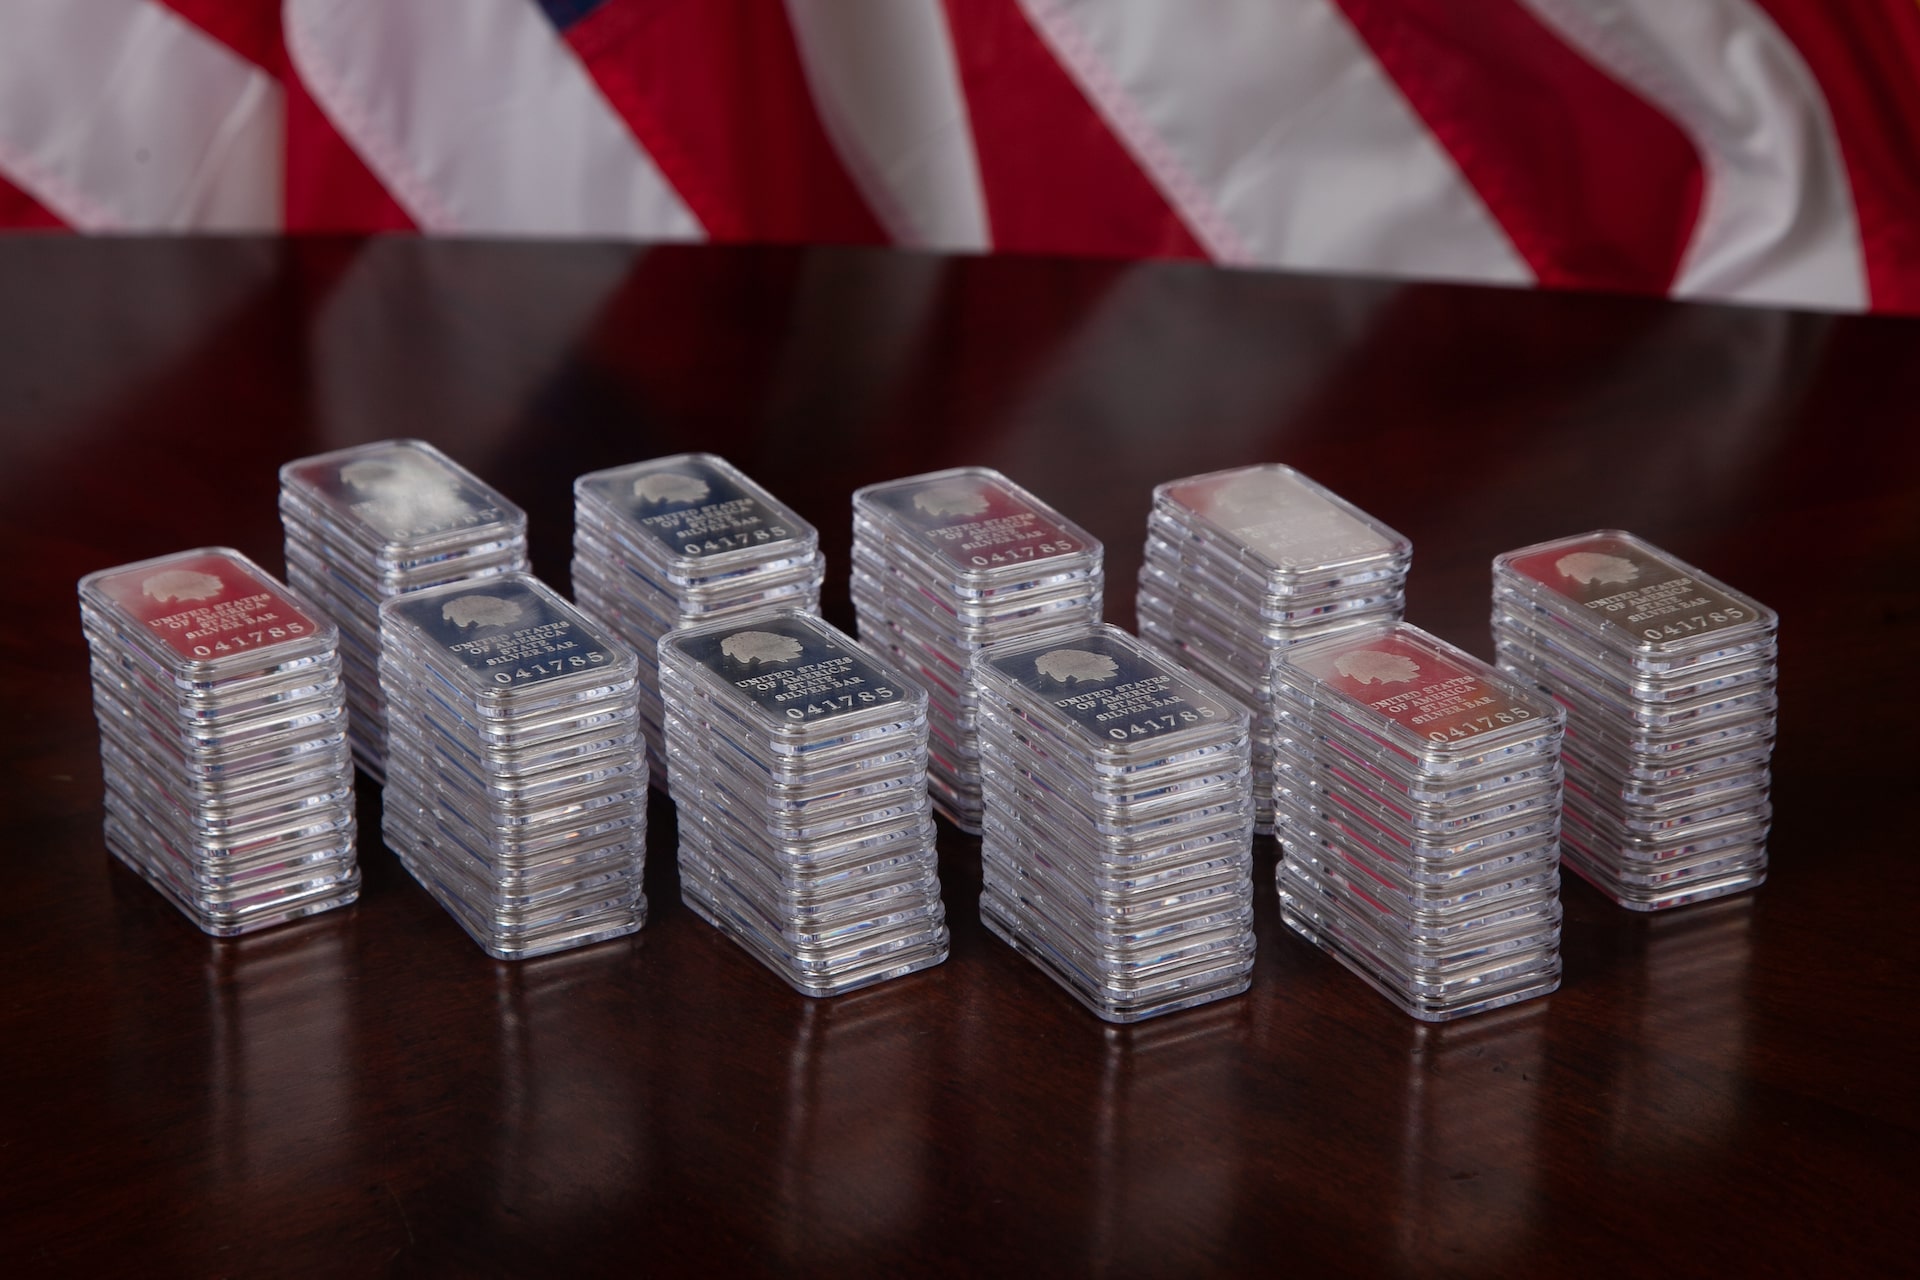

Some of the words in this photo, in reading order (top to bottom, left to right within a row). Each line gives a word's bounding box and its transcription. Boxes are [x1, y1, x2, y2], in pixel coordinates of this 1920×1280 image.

[1584, 591, 1639, 609] UNITED
[1641, 578, 1692, 594] STATES
[1606, 602, 1626, 611] OF
[1630, 586, 1693, 606] AMERICA
[1636, 597, 1682, 611] STATE
[149, 608, 210, 626] UNITED
[213, 593, 270, 611] STATES
[169, 619, 189, 628] OF
[196, 603, 267, 624] AMERICA
[200, 612, 250, 628] STATE
[1628, 605, 1681, 622] SILVER
[1680, 598, 1711, 609] BAR
[185, 622, 243, 639] SILVER
[245, 613, 278, 624] BAR
[450, 634, 510, 651] UNITED
[513, 621, 570, 638] STATES
[1644, 608, 1743, 640] 041785
[194, 622, 304, 656] 041785
[470, 645, 490, 654] OF
[497, 630, 566, 648] AMERICA
[500, 640, 549, 655] STATE
[486, 648, 545, 666] SILVER
[545, 641, 578, 652] BAR
[494, 652, 603, 683] 041785
[736, 670, 794, 688] UNITED
[797, 657, 853, 673] STATES
[757, 681, 777, 690] OF
[782, 666, 851, 685] AMERICA
[775, 684, 831, 701] SILVER
[831, 676, 865, 688] BAR
[788, 675, 836, 691] STATE
[1055, 689, 1113, 708] UNITED
[1115, 676, 1170, 693] STATES
[1368, 690, 1421, 710] UNITED
[1423, 676, 1475, 693] STATES
[786, 687, 893, 719] 041785
[1077, 701, 1097, 710] OF
[1101, 684, 1169, 705] AMERICA
[1096, 705, 1152, 722] SILVER
[1152, 695, 1185, 707] BAR
[1109, 696, 1155, 711] STATE
[1389, 703, 1409, 713] OF
[1412, 685, 1477, 706] AMERICA
[1419, 696, 1466, 713] STATE
[1109, 707, 1215, 739] 041785
[1412, 706, 1465, 725] SILVER
[1465, 696, 1496, 708] BAR
[1429, 707, 1530, 743] 041785
